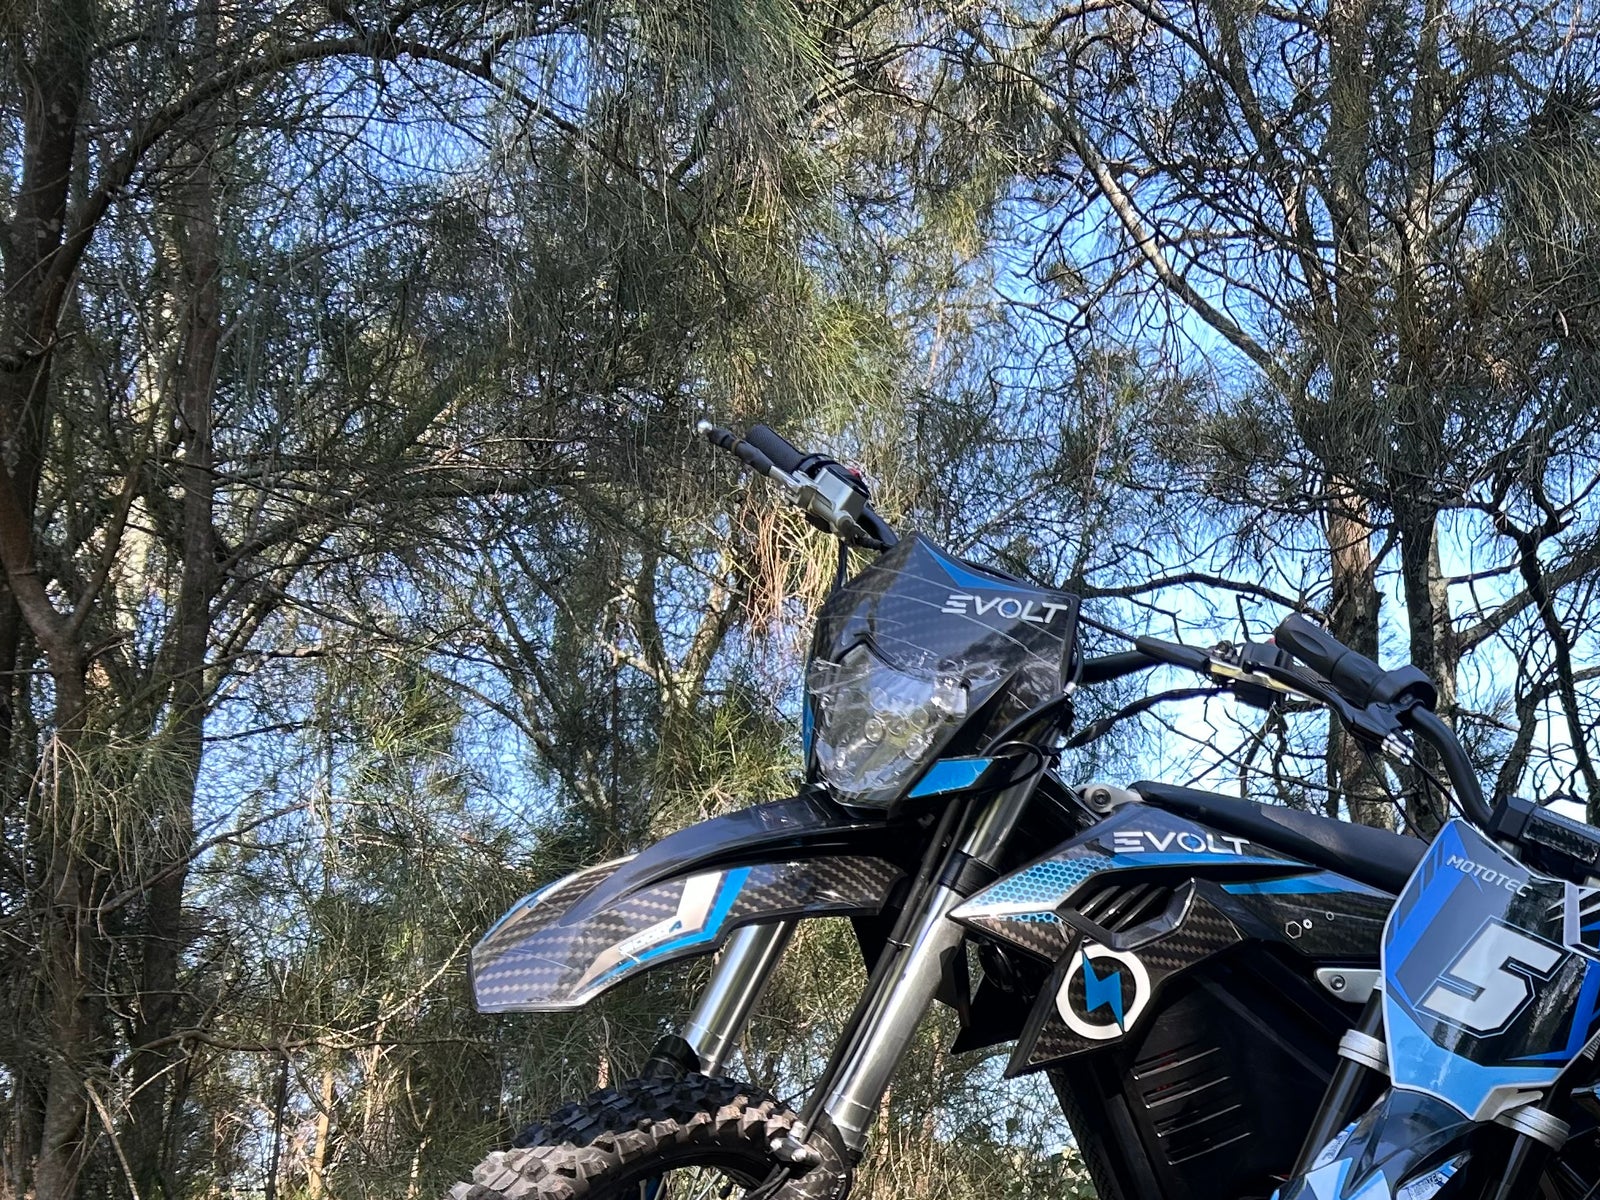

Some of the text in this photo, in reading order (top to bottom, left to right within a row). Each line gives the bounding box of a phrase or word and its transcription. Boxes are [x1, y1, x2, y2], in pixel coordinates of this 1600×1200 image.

[941, 594, 1068, 624] EVOLT
[1113, 831, 1250, 855] EVOLT
[1446, 854, 1534, 898] MOTOTEC
[1421, 921, 1564, 1033] 5
